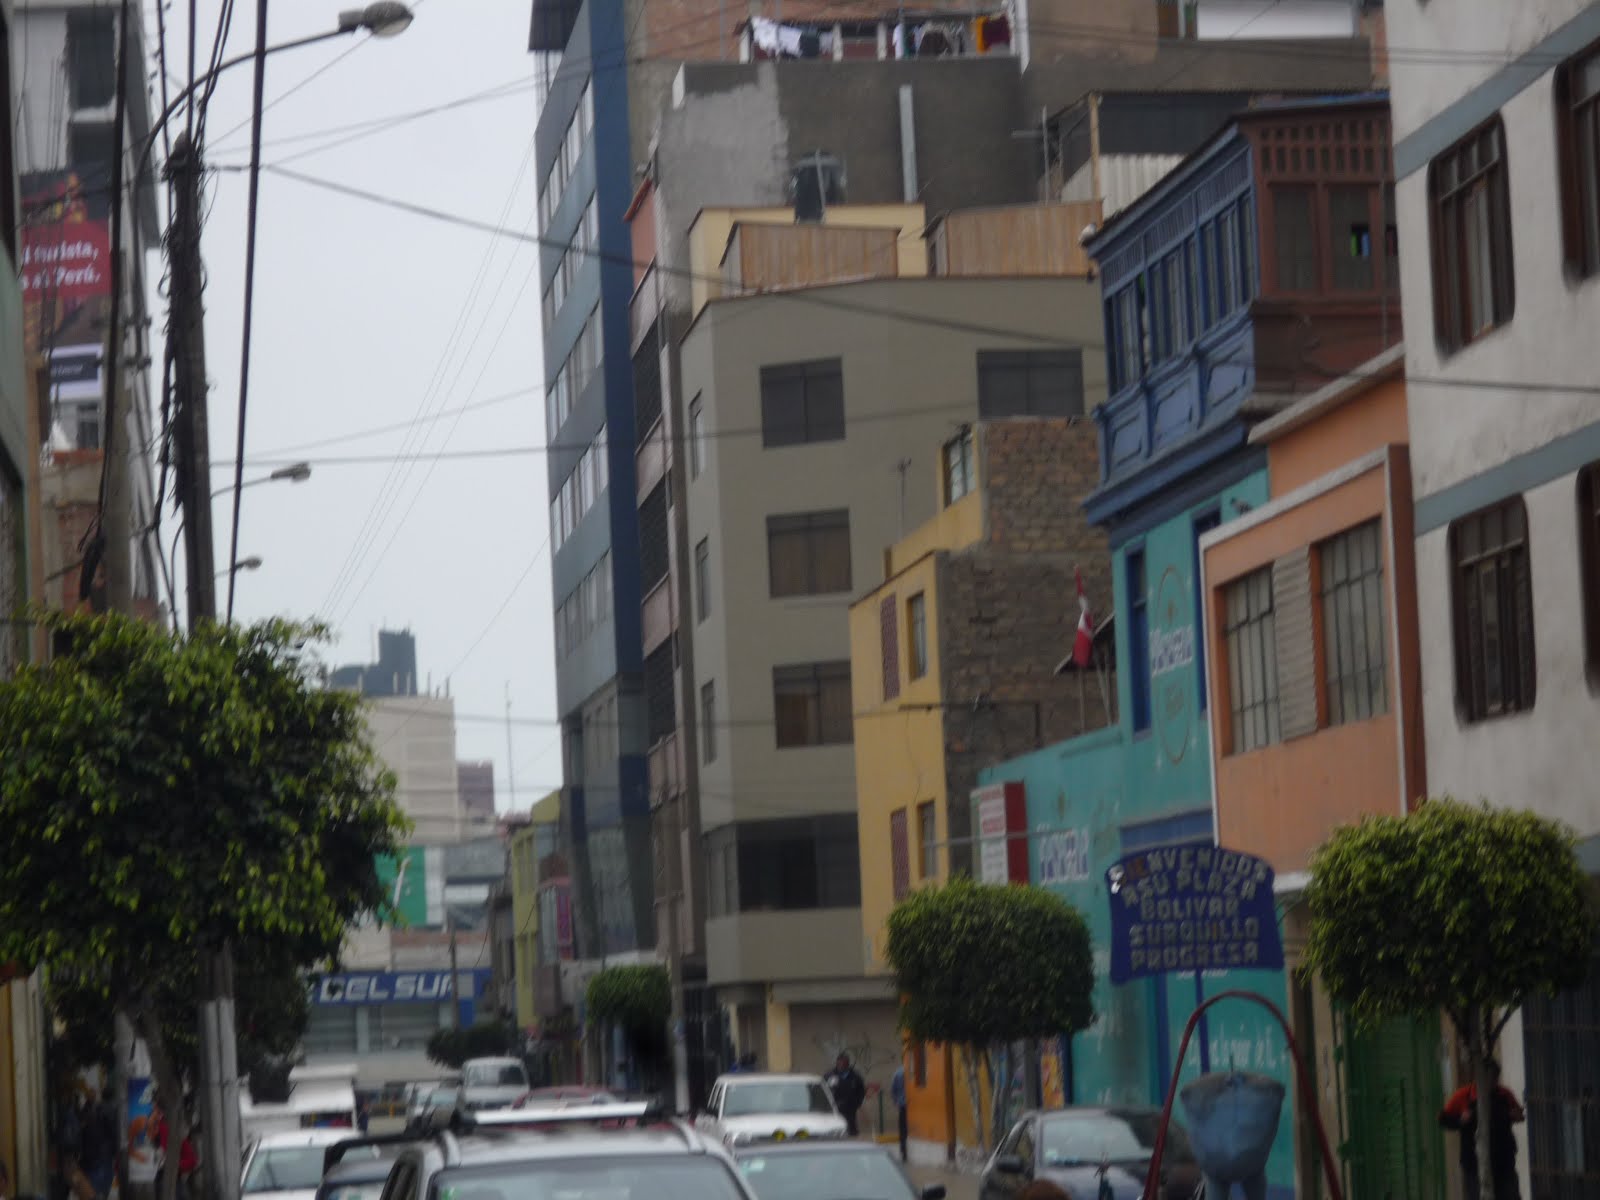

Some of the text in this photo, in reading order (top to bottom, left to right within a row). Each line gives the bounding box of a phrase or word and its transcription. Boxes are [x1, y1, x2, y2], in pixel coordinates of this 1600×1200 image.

[1176, 869, 1257, 900] PLAZA
[1140, 894, 1240, 921] BOLIVAR
[1129, 916, 1259, 947] SURQUILLO
[1131, 942, 1259, 971] PROGRESA
